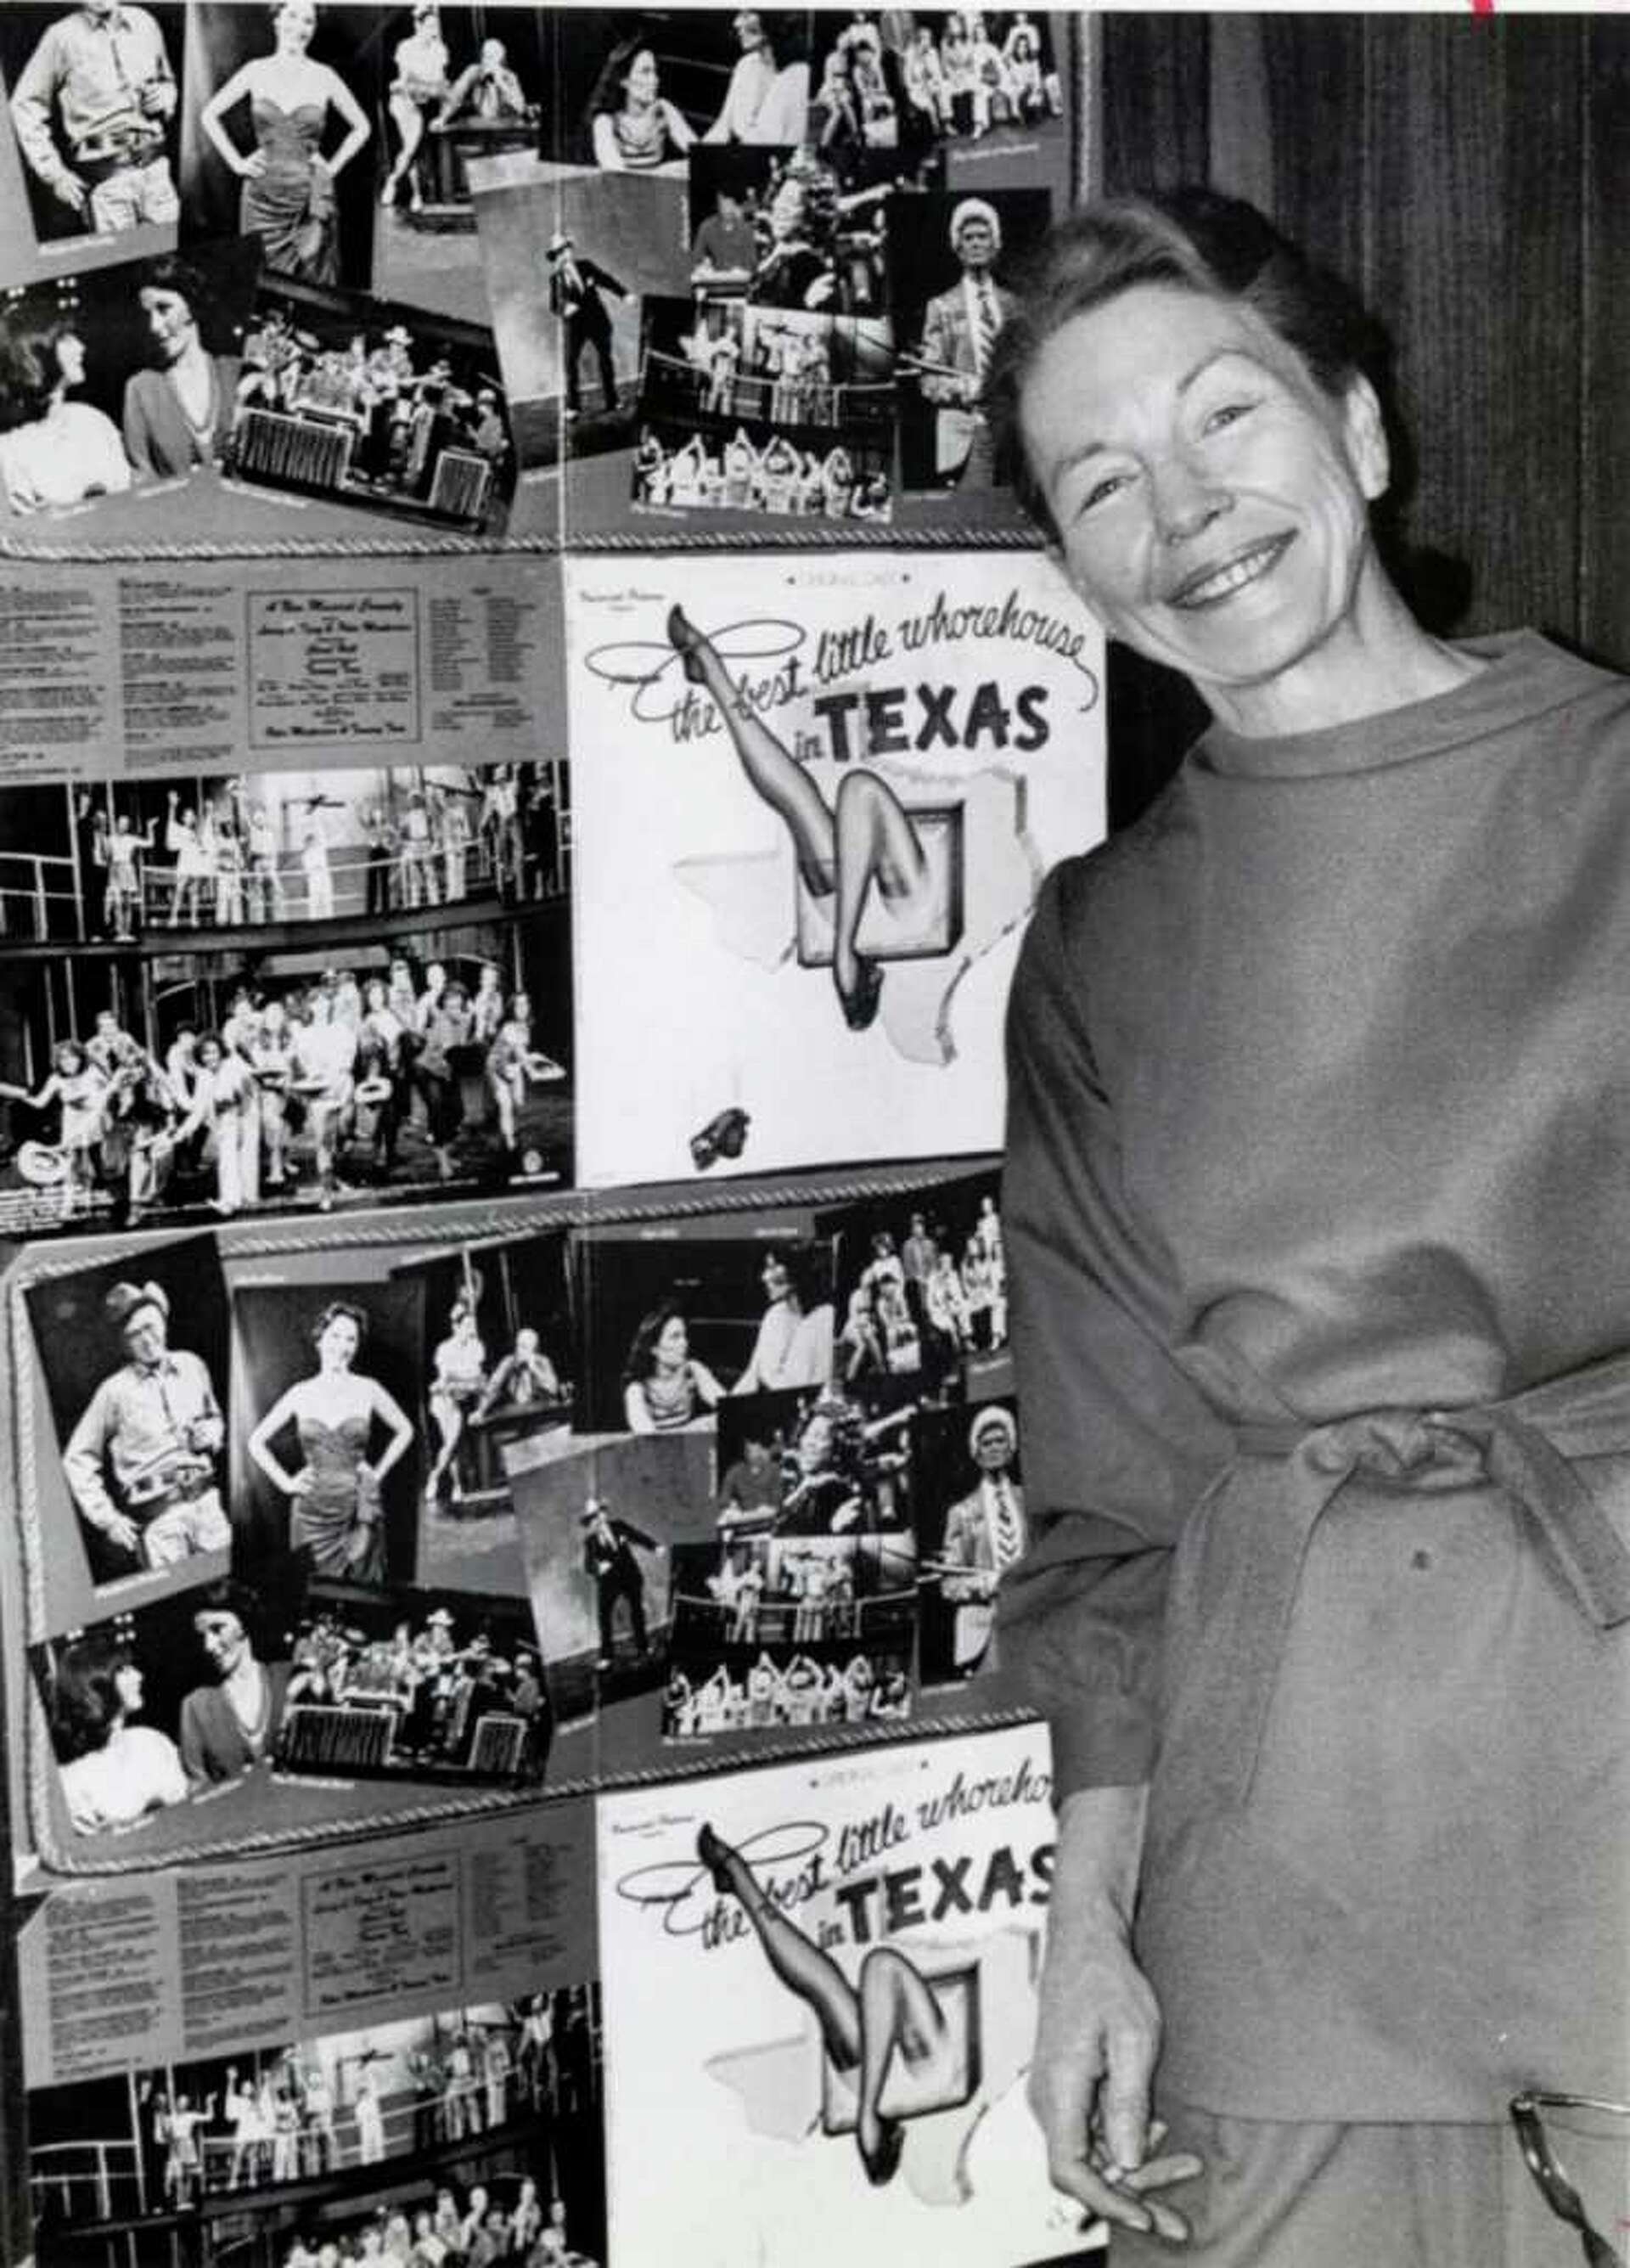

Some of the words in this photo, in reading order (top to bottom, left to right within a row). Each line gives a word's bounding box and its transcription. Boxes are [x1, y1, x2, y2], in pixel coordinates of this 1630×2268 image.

[672, 689, 722, 744] the
[730, 656, 809, 721] best
[812, 613, 893, 684] little
[897, 588, 1086, 658] whorehouse
[795, 729, 824, 763] in
[812, 681, 1050, 763] TEXAS
[701, 1899, 751, 1950] the
[835, 1803, 911, 1875] little
[817, 1919, 846, 1950] in
[835, 1843, 1055, 1944] TEXAS
